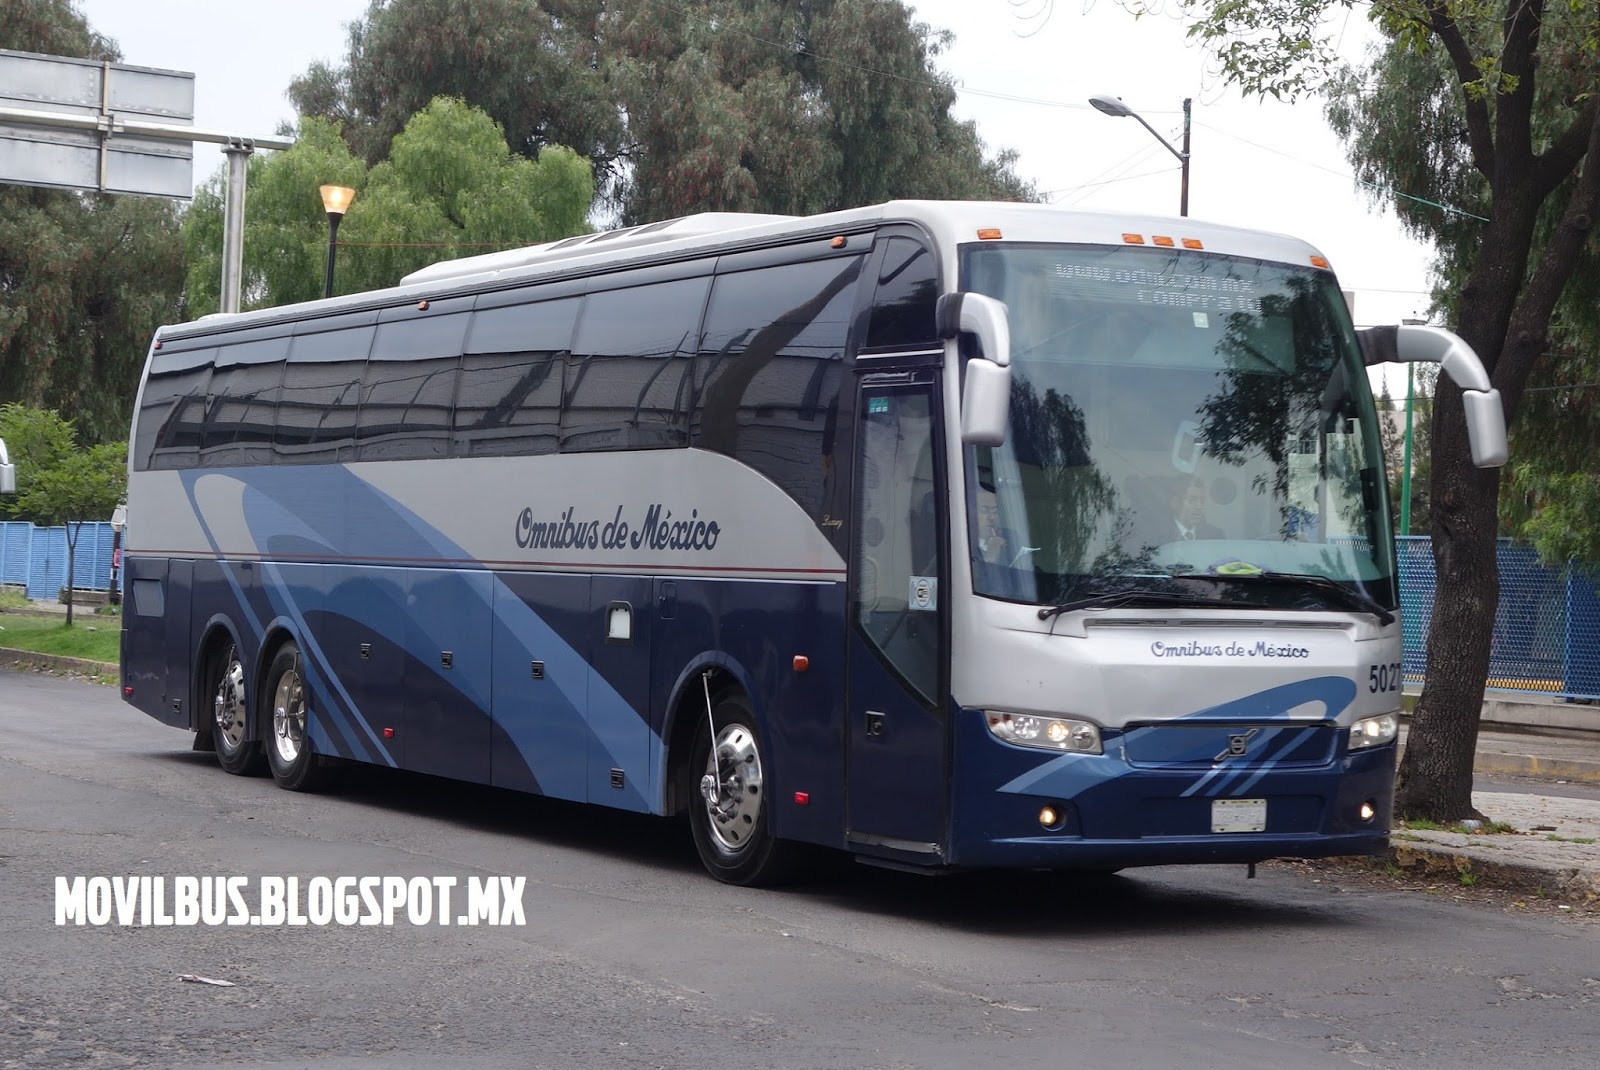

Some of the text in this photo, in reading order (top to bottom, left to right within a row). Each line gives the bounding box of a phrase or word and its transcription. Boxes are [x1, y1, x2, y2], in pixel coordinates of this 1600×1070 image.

[515, 504, 721, 550] Omnibus de México
[1151, 641, 1310, 659] Omnibus de México
